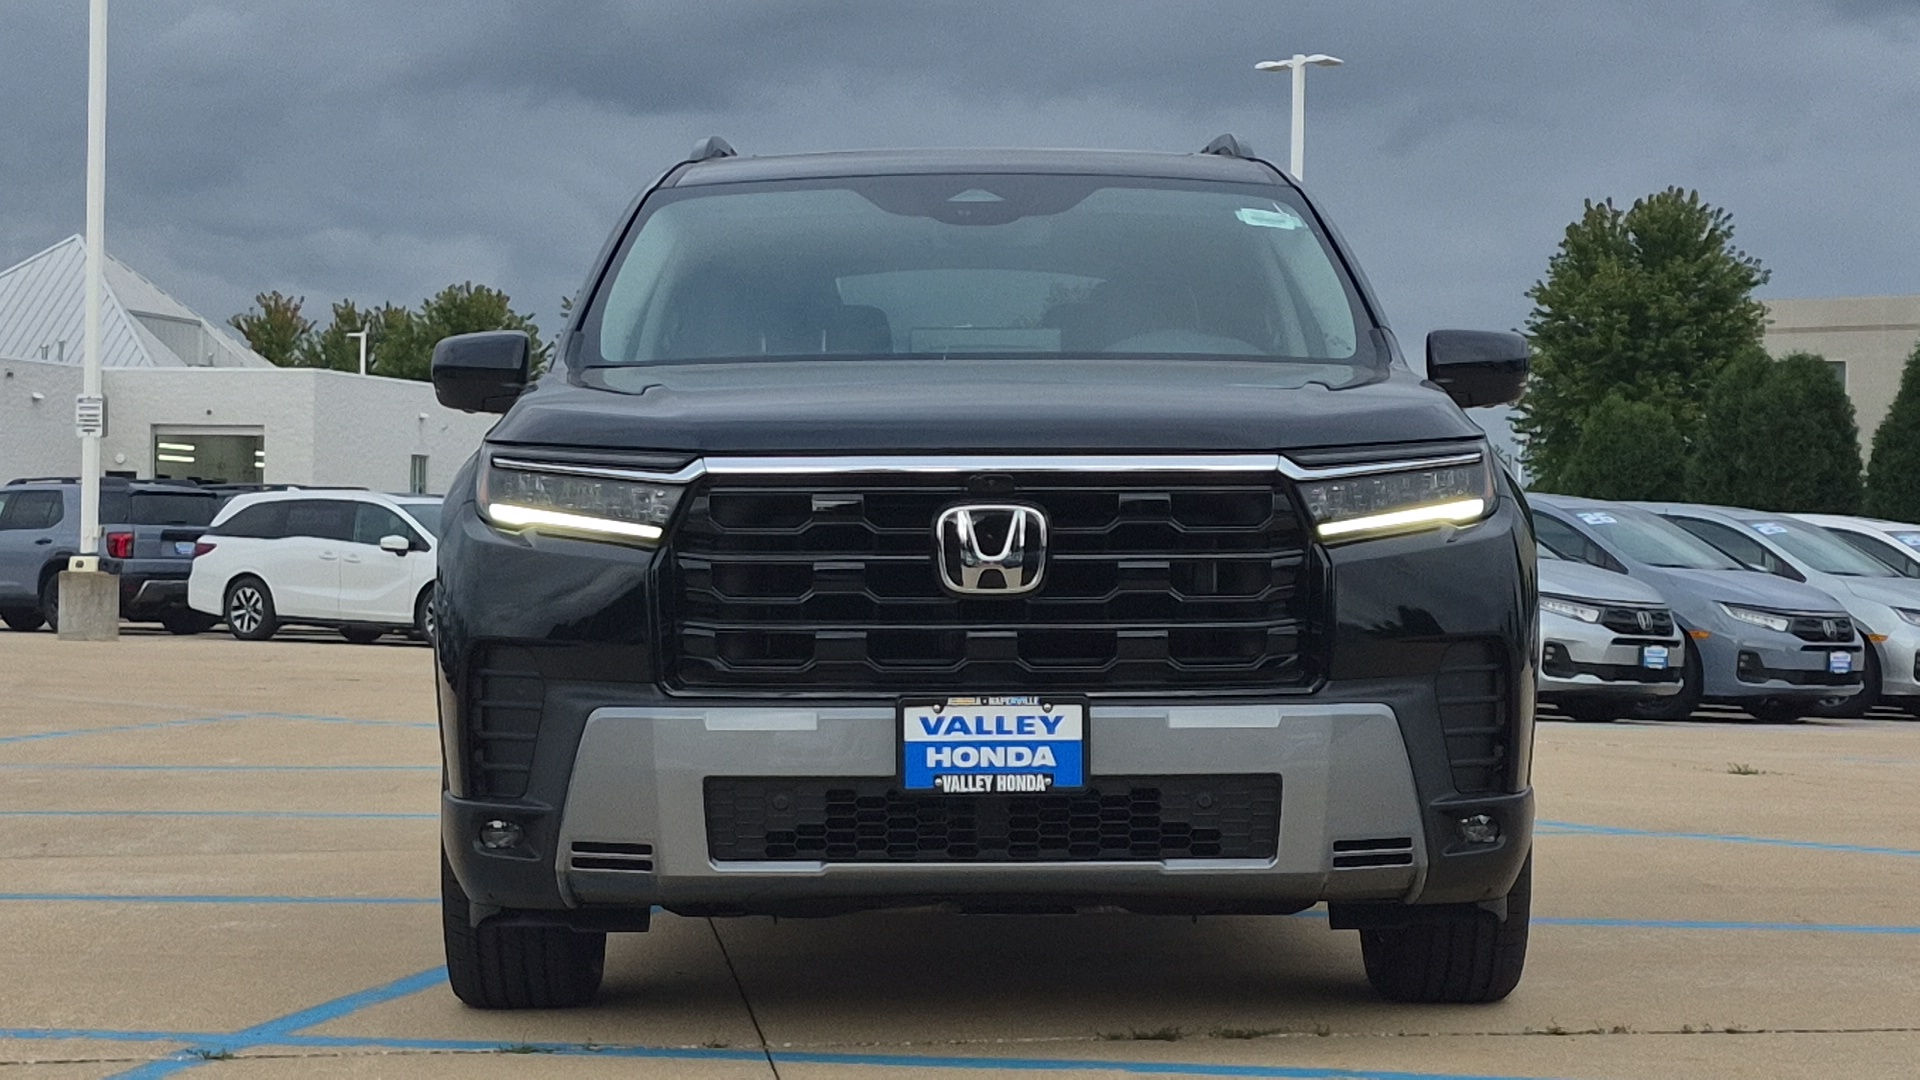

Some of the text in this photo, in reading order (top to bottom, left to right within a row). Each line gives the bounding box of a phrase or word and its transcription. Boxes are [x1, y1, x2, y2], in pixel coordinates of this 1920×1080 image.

[919, 715, 1065, 735] VALLEY
[926, 746, 1057, 768] HONDA
[942, 774, 1046, 793] VALLEY HONDA
